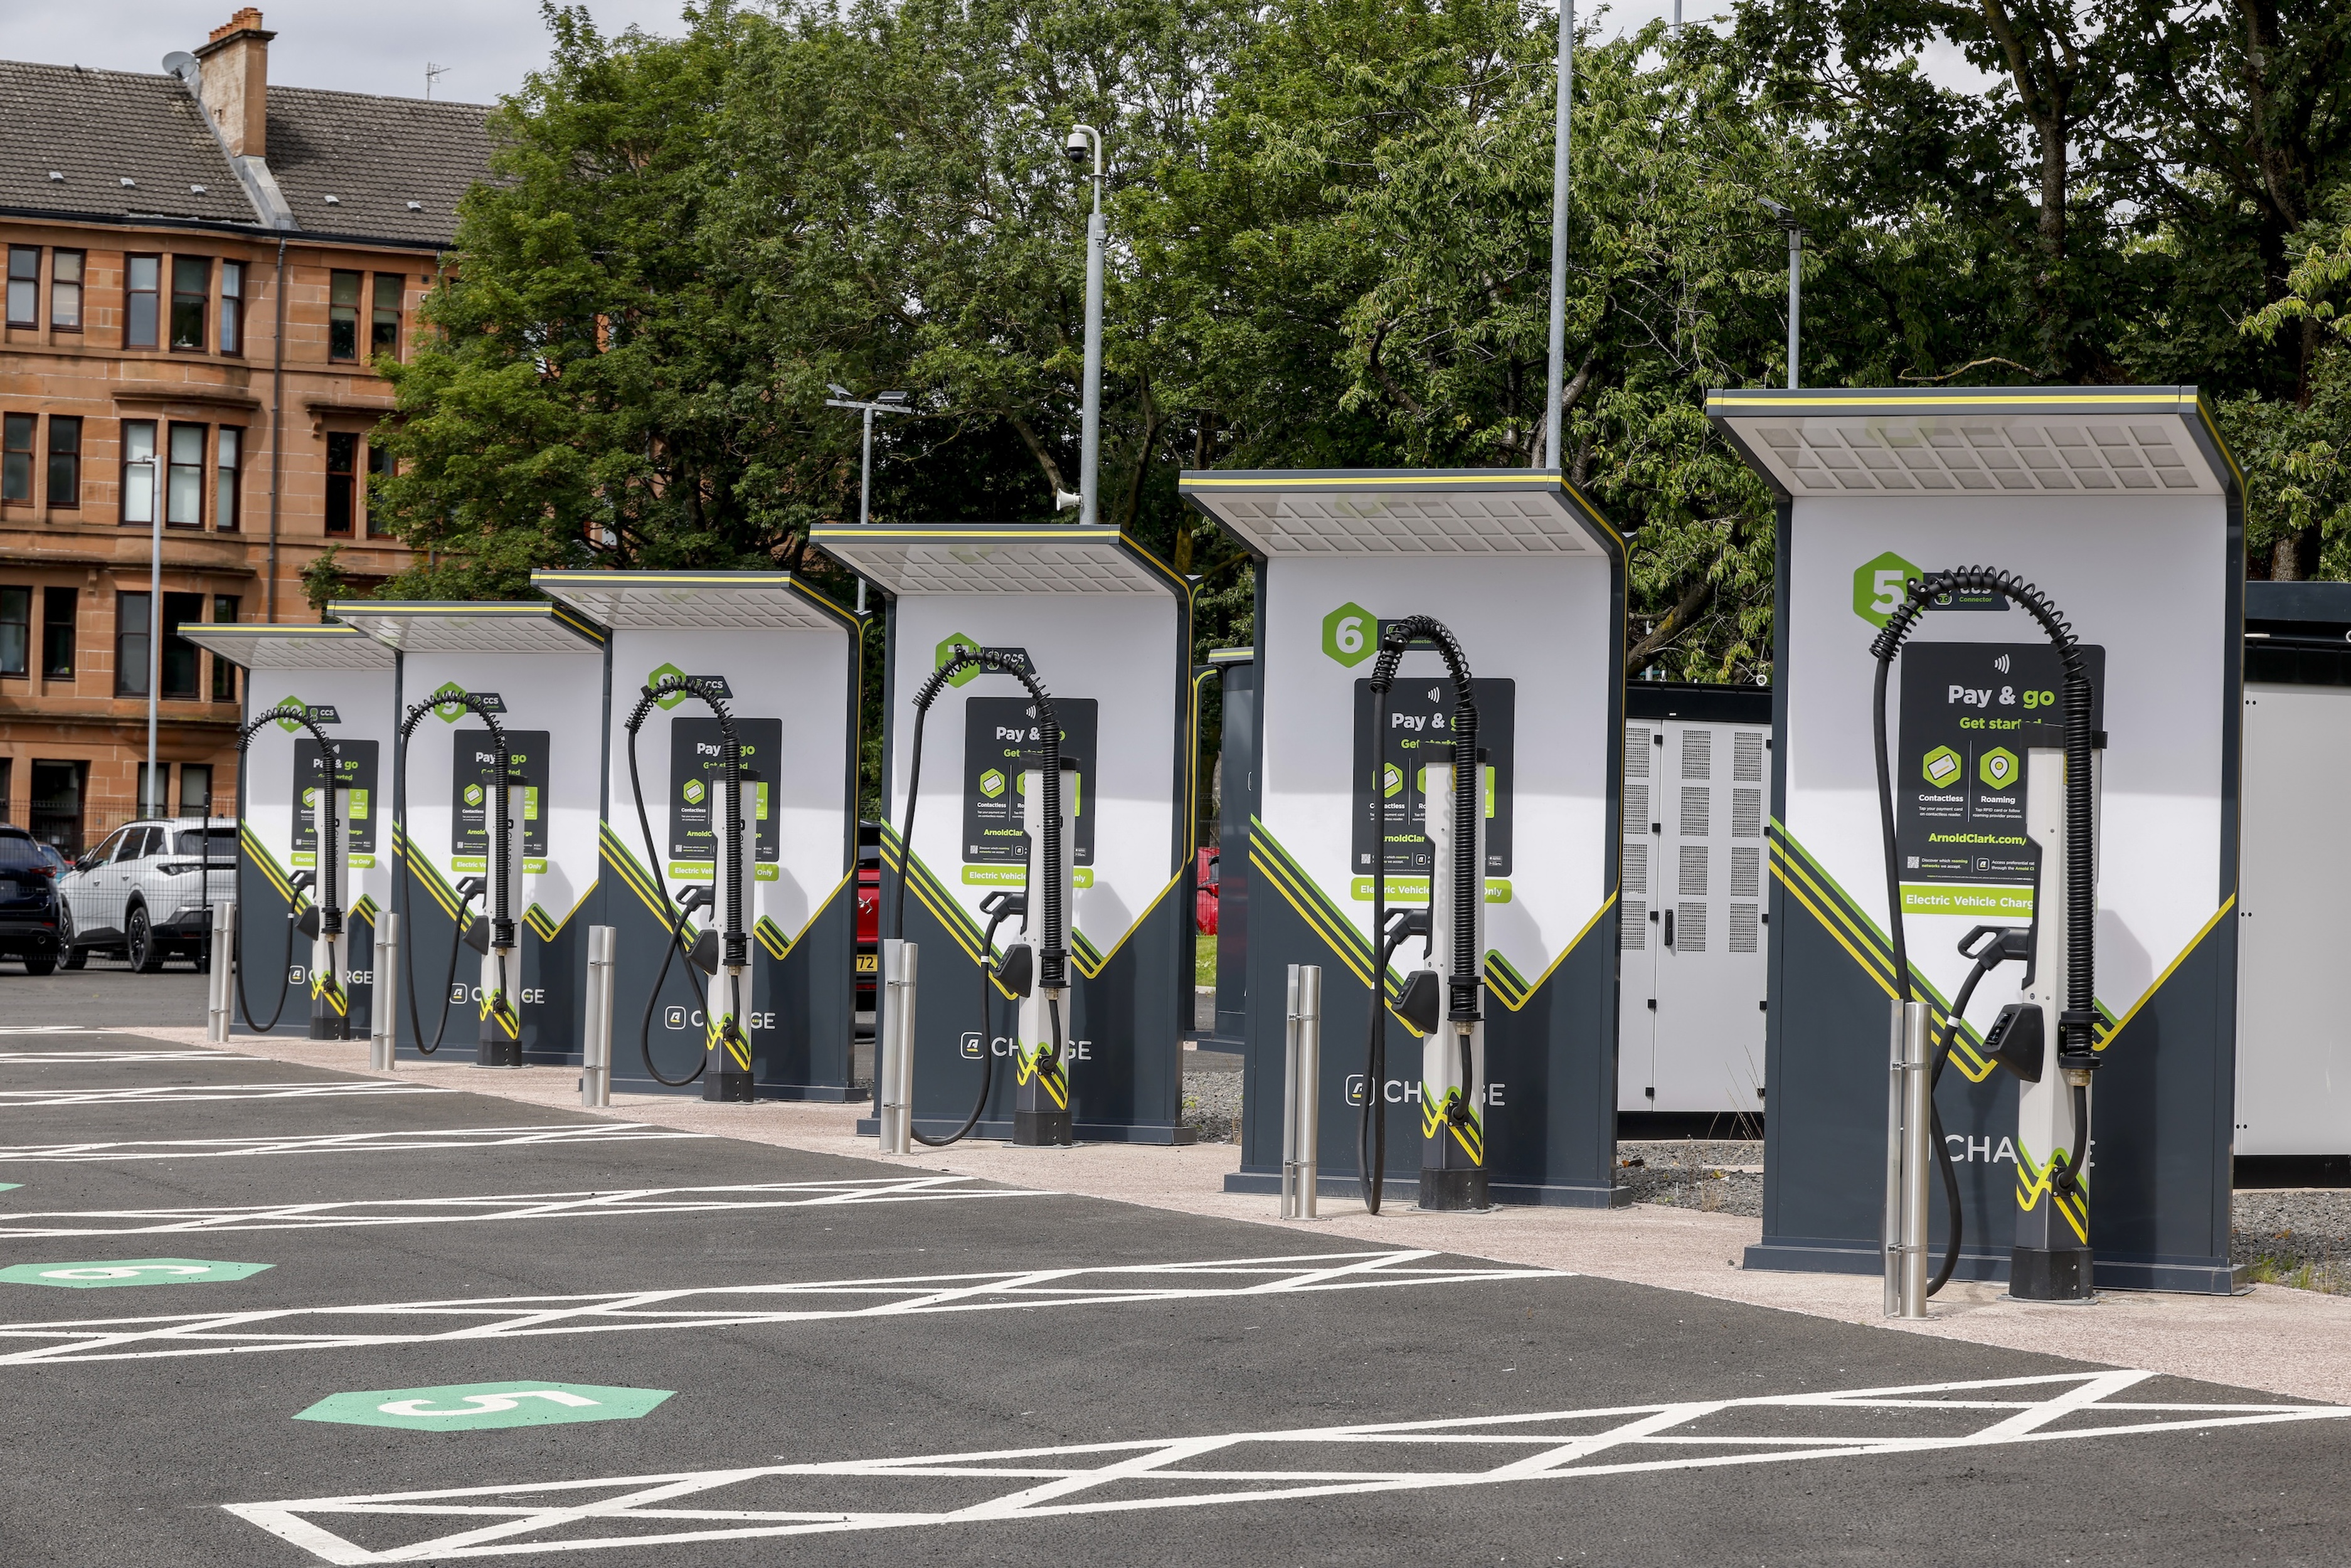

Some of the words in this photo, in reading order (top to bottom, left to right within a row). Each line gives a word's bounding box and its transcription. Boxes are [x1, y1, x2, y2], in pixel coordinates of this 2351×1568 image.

[1870, 570, 1906, 615] 5
[1335, 617, 1364, 654] 6
[1948, 685, 1992, 708] Pay
[1998, 686, 2016, 705] &
[2023, 690, 2055, 709] go
[1392, 712, 1426, 731] Pay
[1431, 712, 1445, 728] &
[1960, 717, 1985, 729] Get
[1988, 718, 2042, 729] start
[996, 726, 1025, 743] Pay
[1029, 727, 1041, 740] &
[697, 743, 721, 757] Pay
[1004, 749, 1021, 758] Get
[475, 752, 496, 765] Pay
[511, 755, 527, 765] go
[344, 761, 358, 771] go
[1919, 794, 1963, 802] Contactless
[1980, 795, 2015, 805] Roaming
[969, 871, 998, 879] Electric
[1074, 874, 1086, 883] nly
[1361, 885, 1396, 893] Eleric
[1906, 895, 1950, 905] Electric
[1954, 896, 1997, 906] Vehicle
[857, 956, 874, 968] 72
[471, 987, 544, 1004] CGE
[691, 1010, 775, 1029] CGE
[39, 1264, 211, 1280] 6
[376, 1390, 601, 1417] 5
